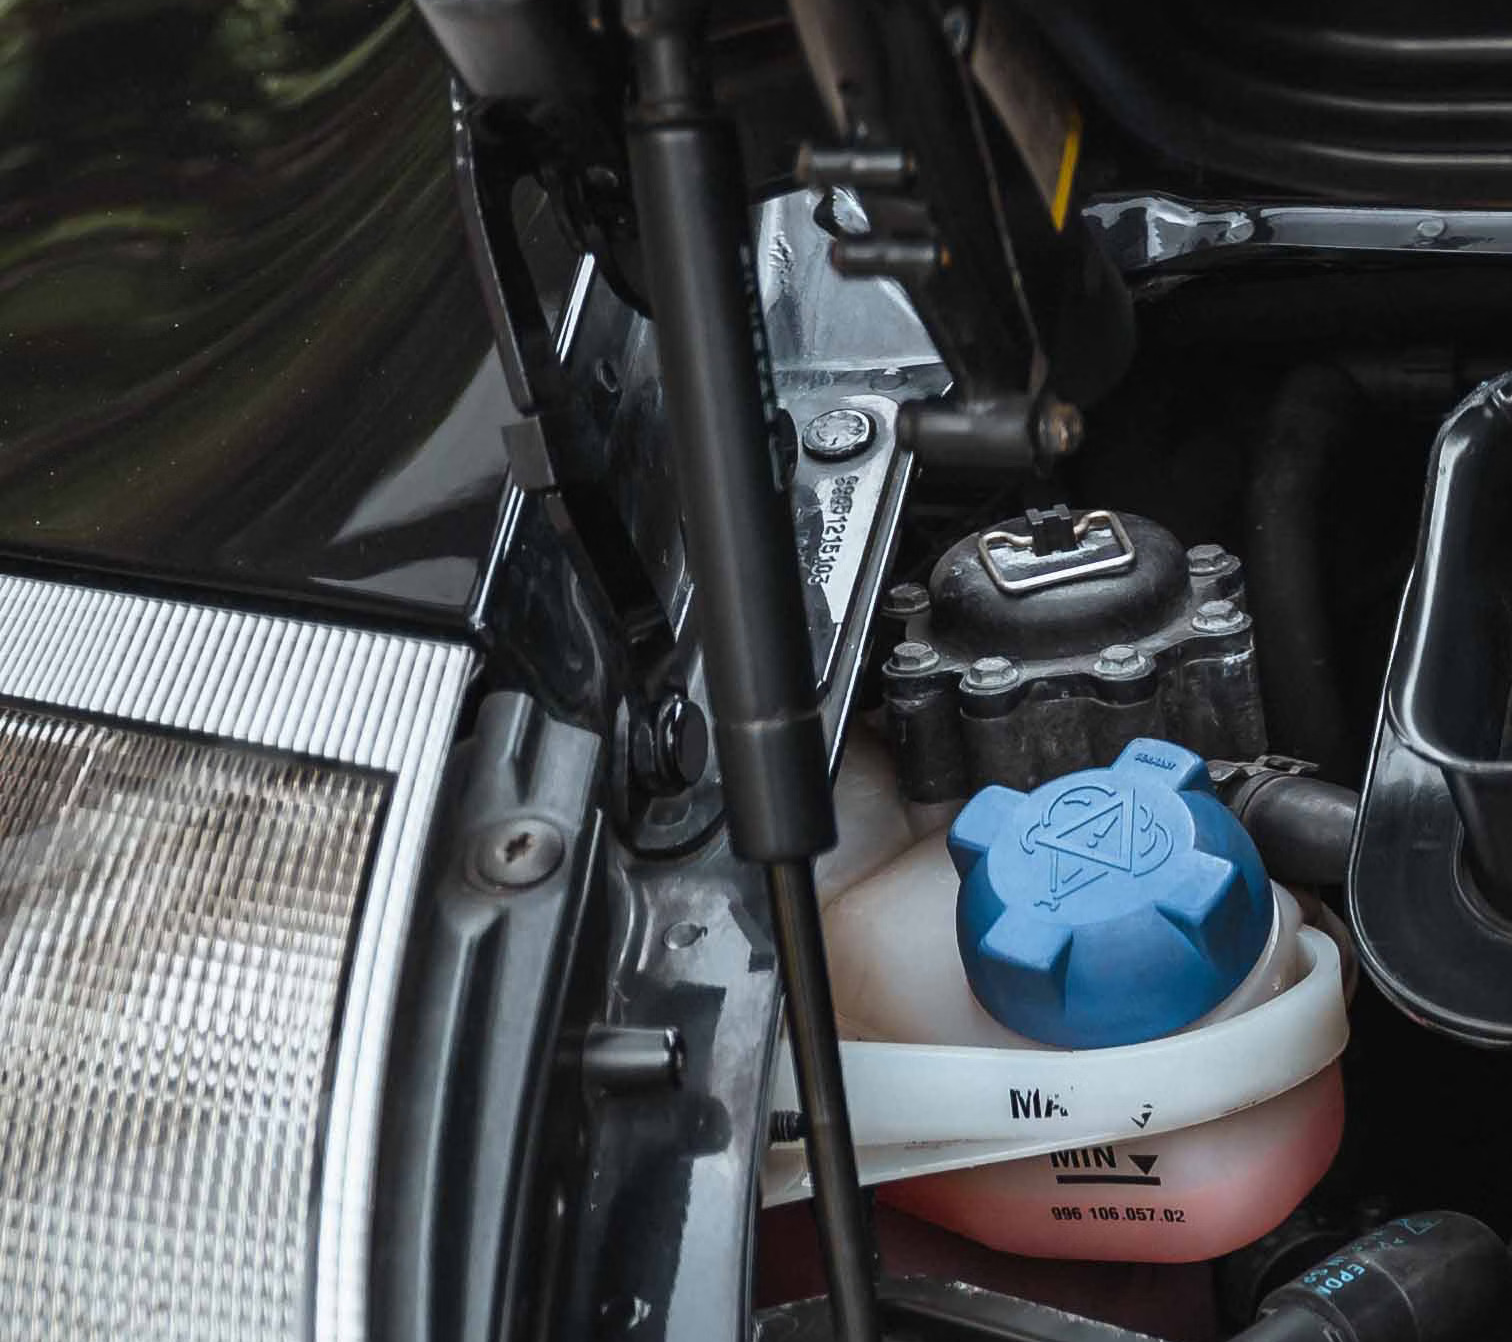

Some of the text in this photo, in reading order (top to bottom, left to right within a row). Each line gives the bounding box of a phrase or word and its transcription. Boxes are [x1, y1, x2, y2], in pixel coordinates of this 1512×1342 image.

[1009, 1087, 1069, 1120] MA
[1050, 1145, 1117, 1169] MIN
[1052, 1206, 1186, 1224] 996 106.057.02
